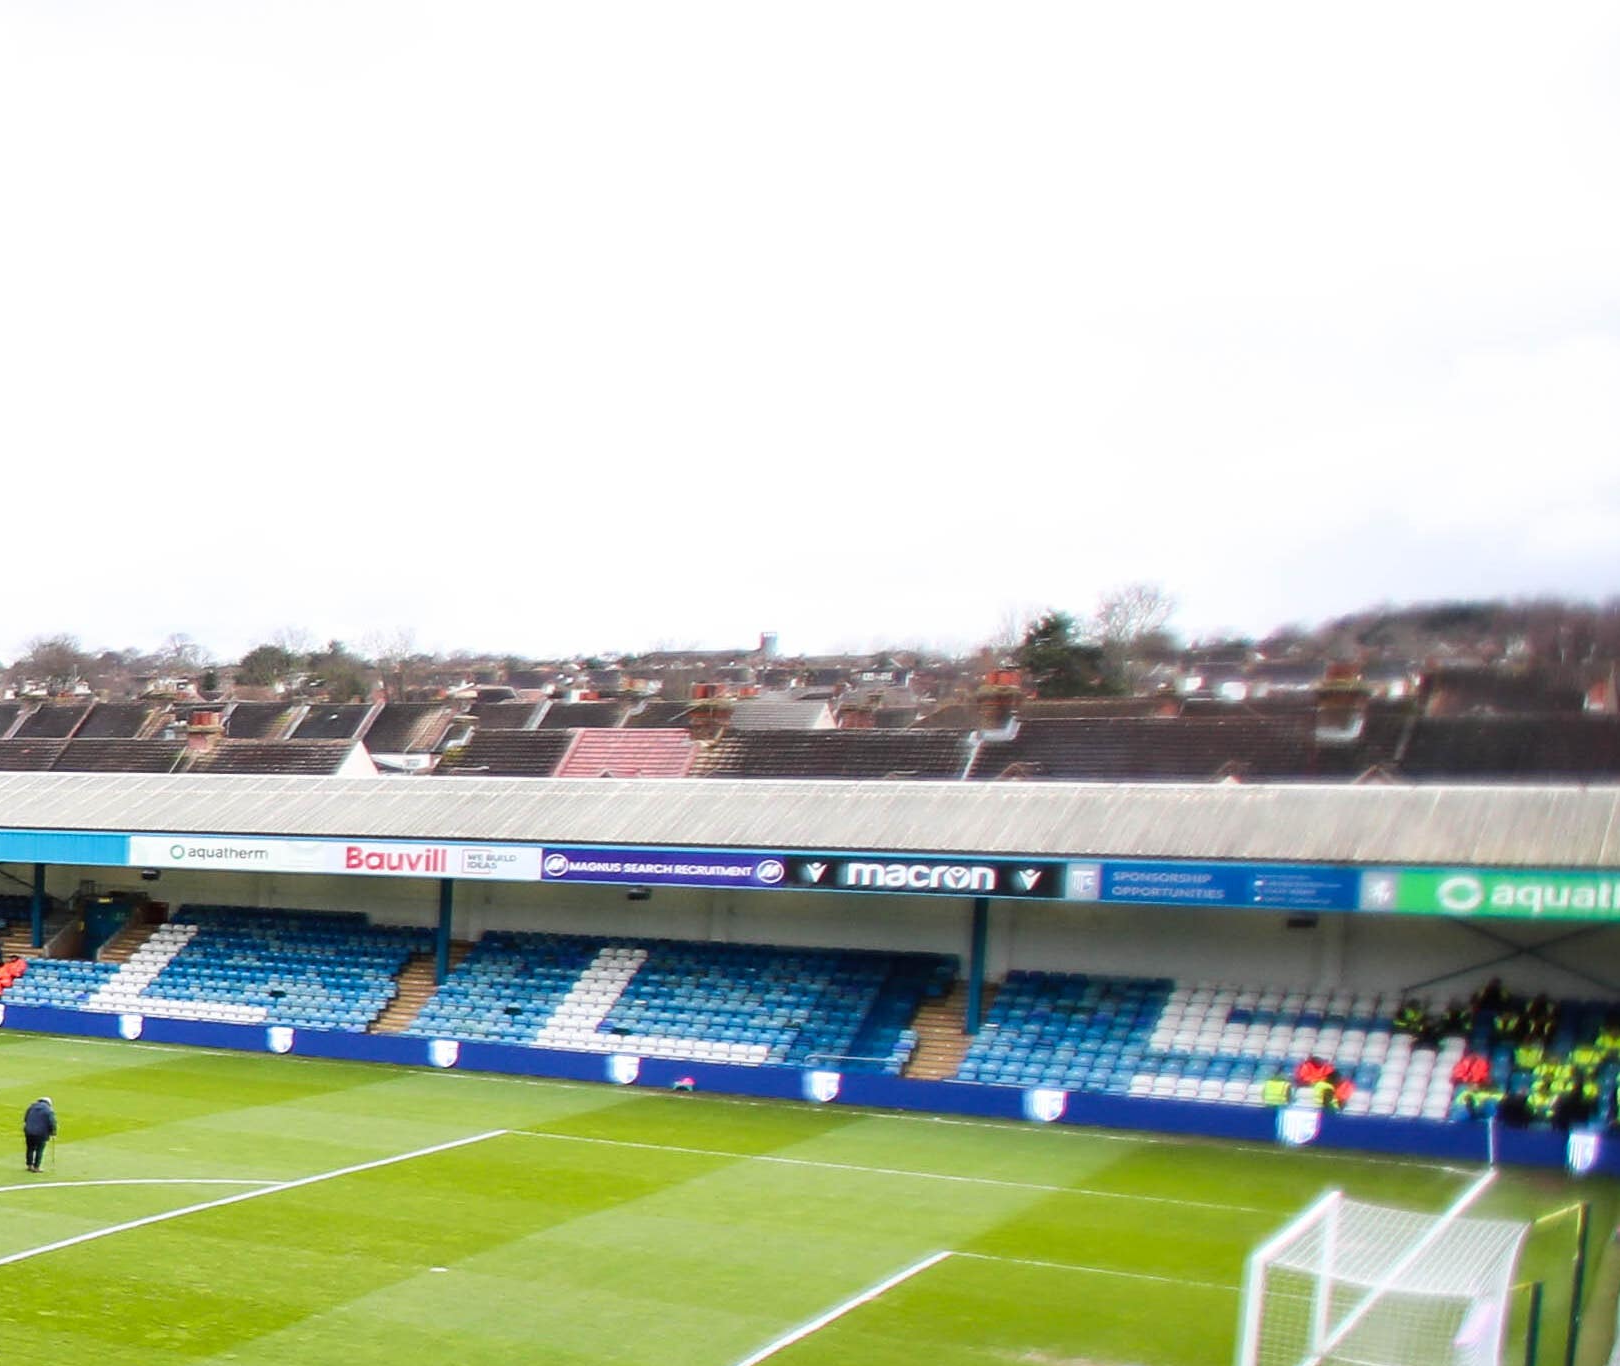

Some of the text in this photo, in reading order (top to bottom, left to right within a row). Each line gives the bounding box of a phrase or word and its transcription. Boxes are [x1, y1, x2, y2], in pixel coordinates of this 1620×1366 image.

[187, 846, 269, 860] aquatherm
[346, 845, 448, 873] Bauvill
[569, 862, 753, 877] MAGNUS SEARCH RECRUITMENT
[846, 863, 996, 890] macron
[1112, 871, 1213, 883] SPONSORSHIP
[1112, 886, 1225, 899] OPPORTUNITIES
